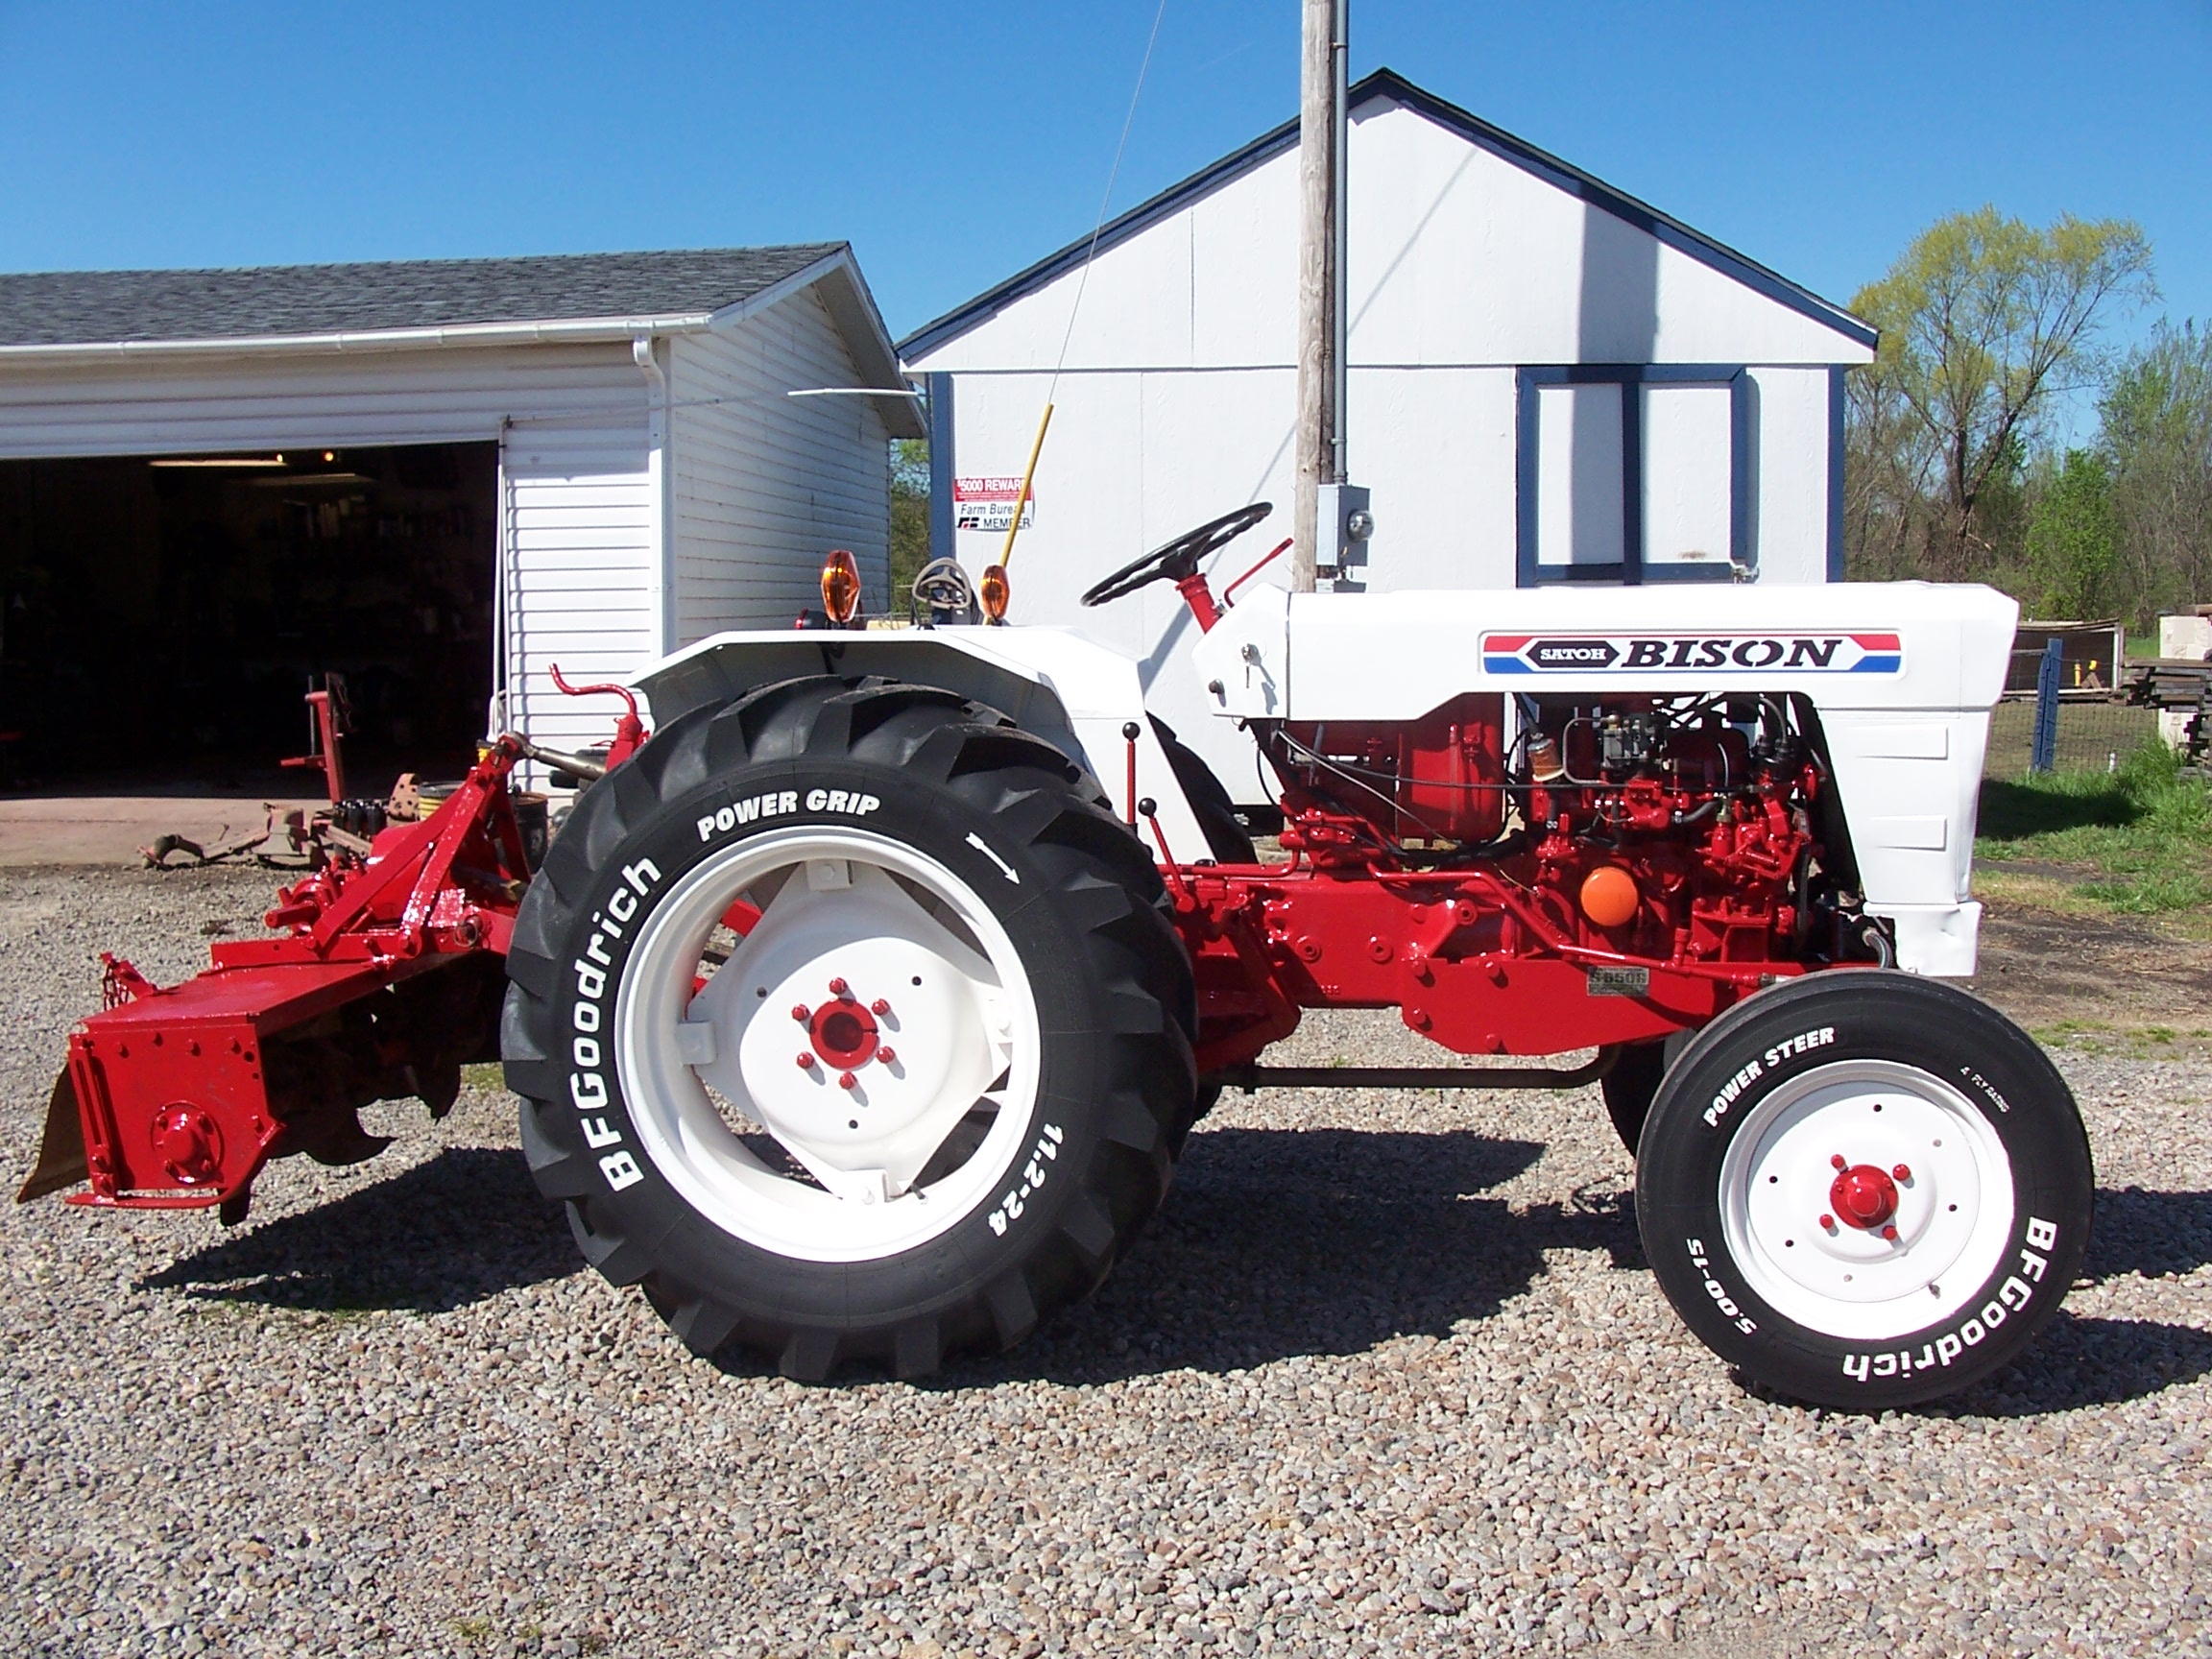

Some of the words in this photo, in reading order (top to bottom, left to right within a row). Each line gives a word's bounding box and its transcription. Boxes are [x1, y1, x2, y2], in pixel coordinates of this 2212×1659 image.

[960, 504, 986, 515] Farm
[984, 479, 1024, 492] REWAR
[1540, 648, 1606, 661] SATOH
[1621, 639, 1842, 668] BISON
[696, 790, 797, 842] POWER
[805, 788, 880, 816] GRIP
[569, 857, 661, 1192] BFGoodrich
[1703, 1060, 1763, 1127] POWER
[1765, 1026, 1836, 1068] STEER
[988, 1123, 1064, 1237] 11.2-24
[1686, 1238, 1757, 1334] 5.00-15
[1842, 1216, 2057, 1382] BFGoodrich
